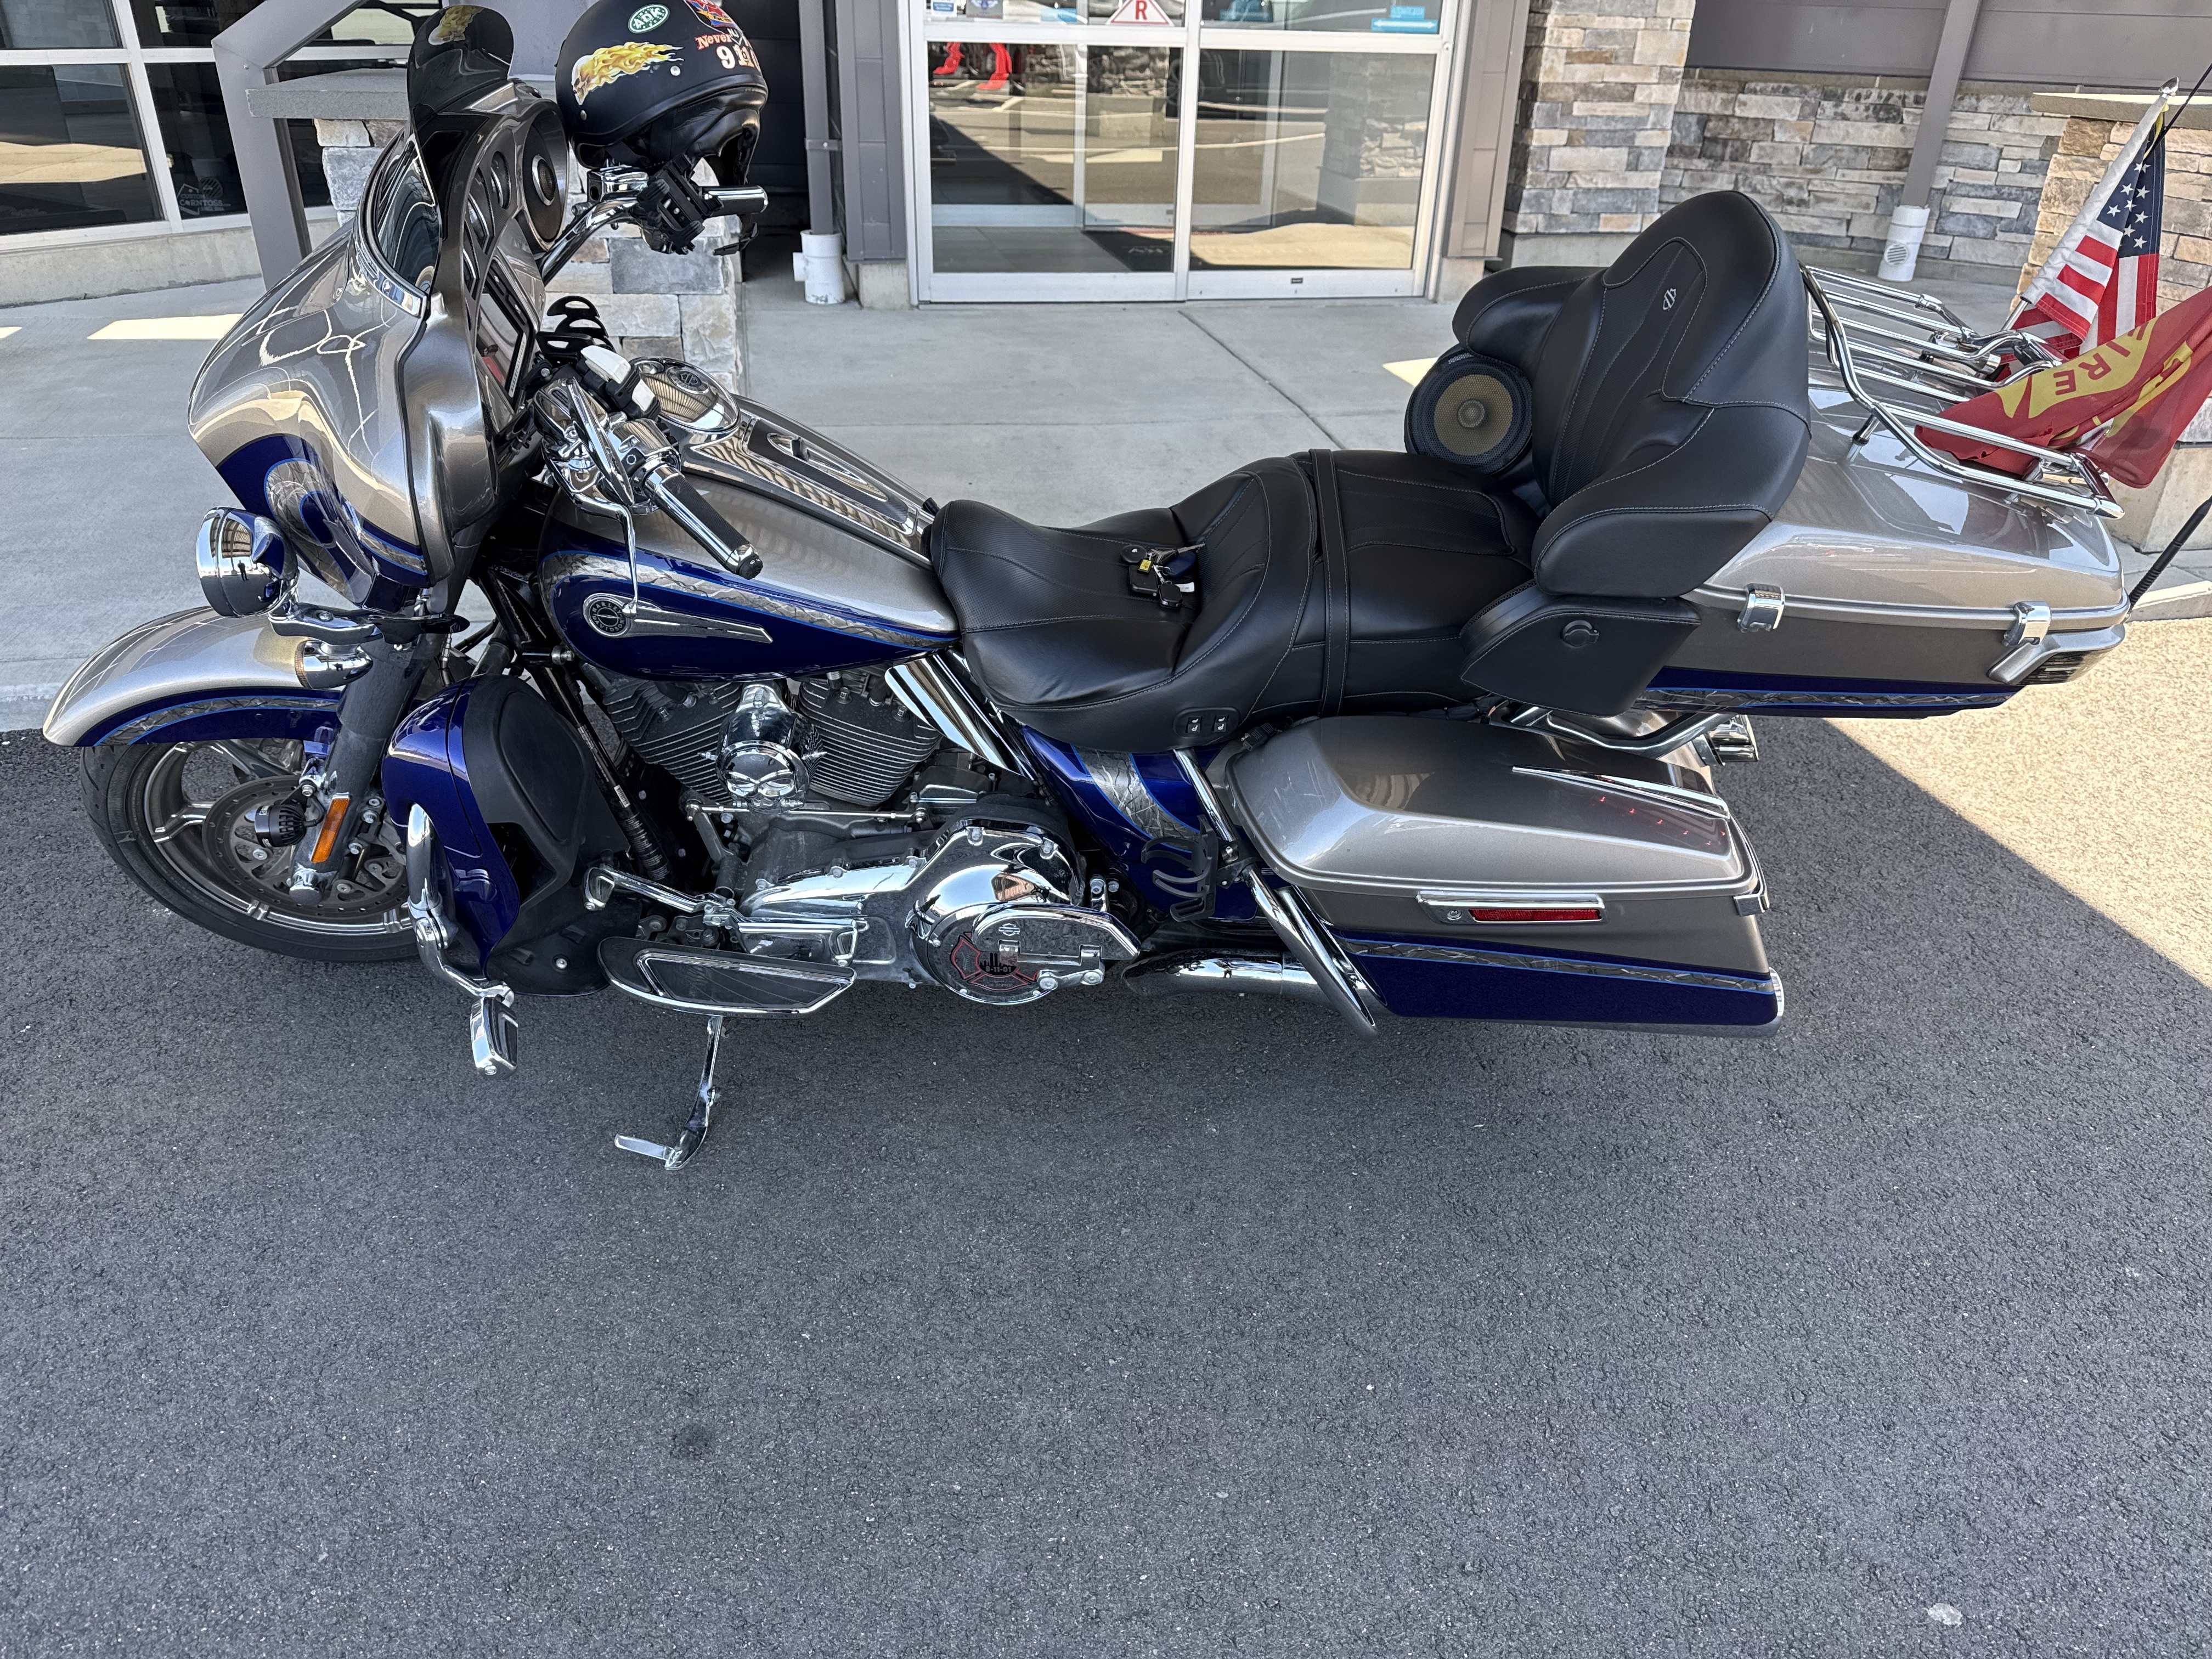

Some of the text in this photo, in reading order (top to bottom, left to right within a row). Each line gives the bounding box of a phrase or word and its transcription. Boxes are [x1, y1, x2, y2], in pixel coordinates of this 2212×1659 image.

[634, 8, 662, 29] ADK
[1135, 0, 1147, 20] R
[694, 33, 732, 50] Never
